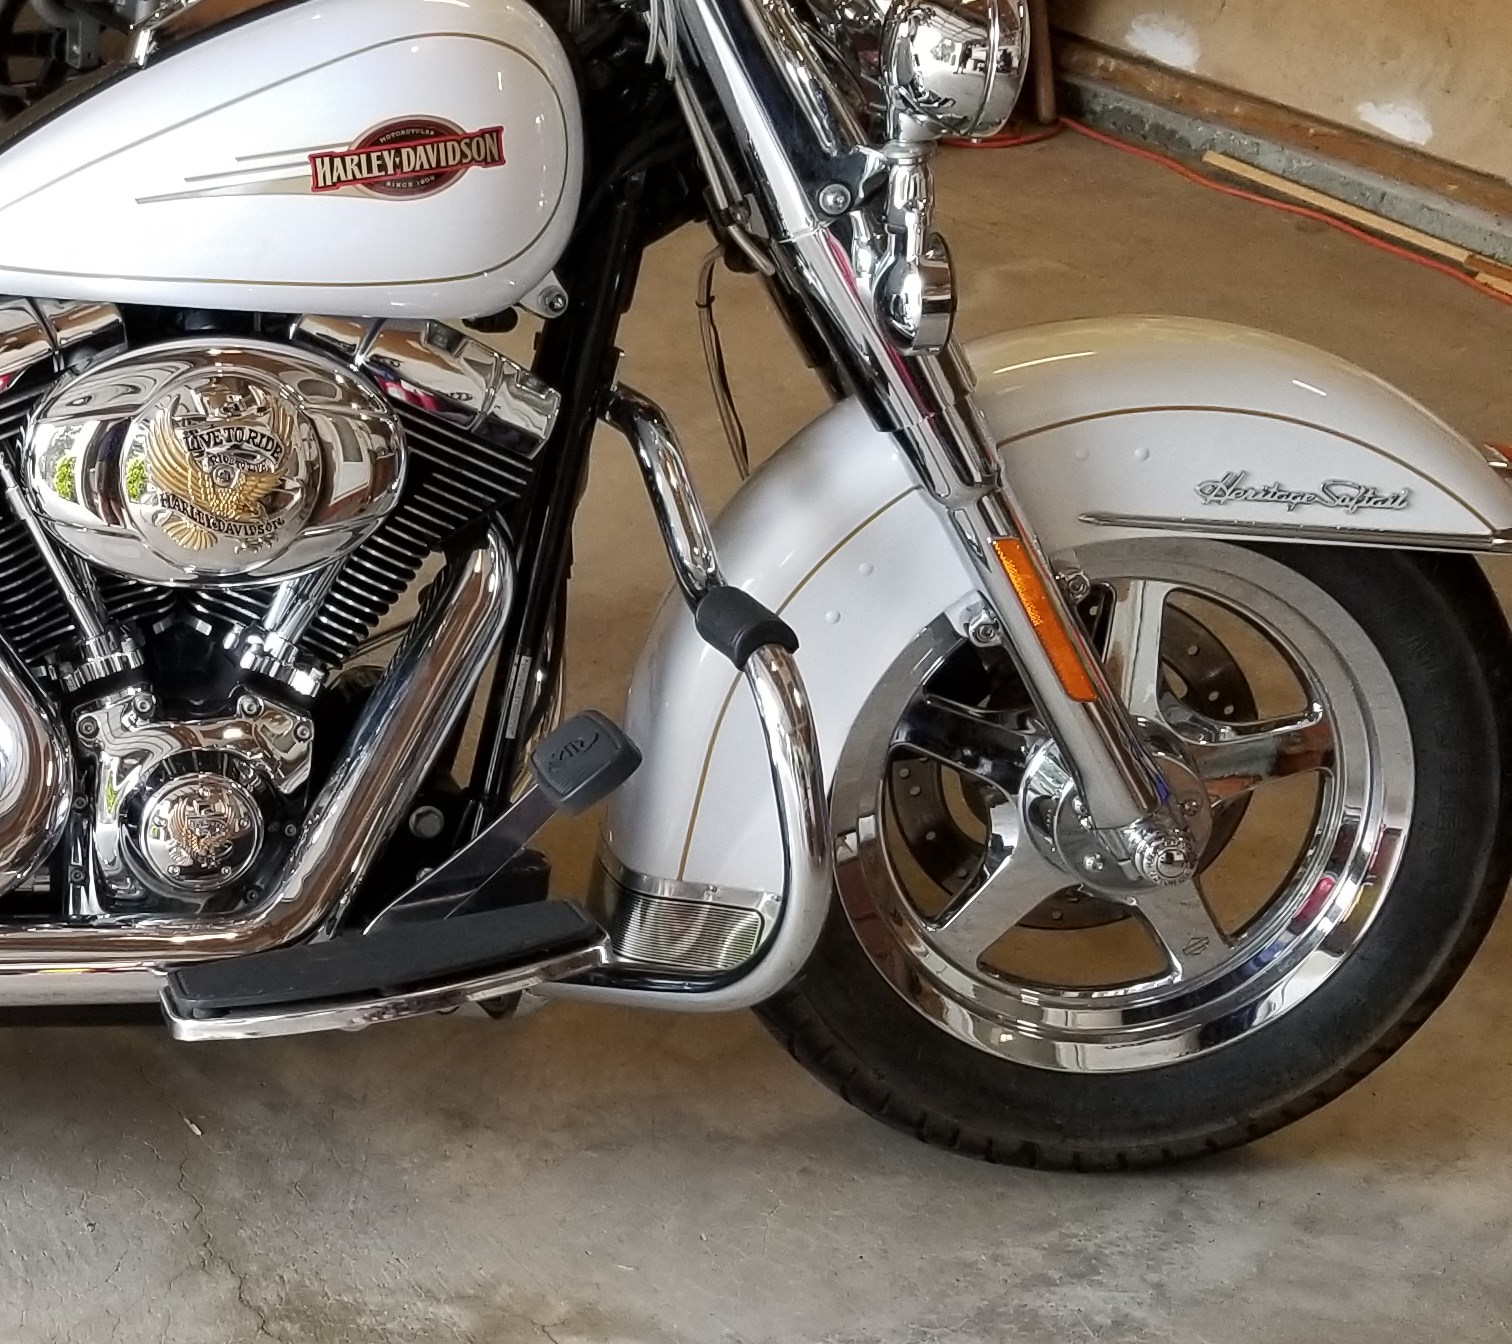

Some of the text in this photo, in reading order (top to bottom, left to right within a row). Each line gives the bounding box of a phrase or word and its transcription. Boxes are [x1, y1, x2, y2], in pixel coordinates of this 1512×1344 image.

[314, 132, 500, 188] HARLEY-DAVIDSON
[184, 427, 284, 462] LIVE TO RIDE
[1194, 469, 1413, 515] Heritage Softail
[160, 493, 285, 536] HARLEY-DAVIDSON
